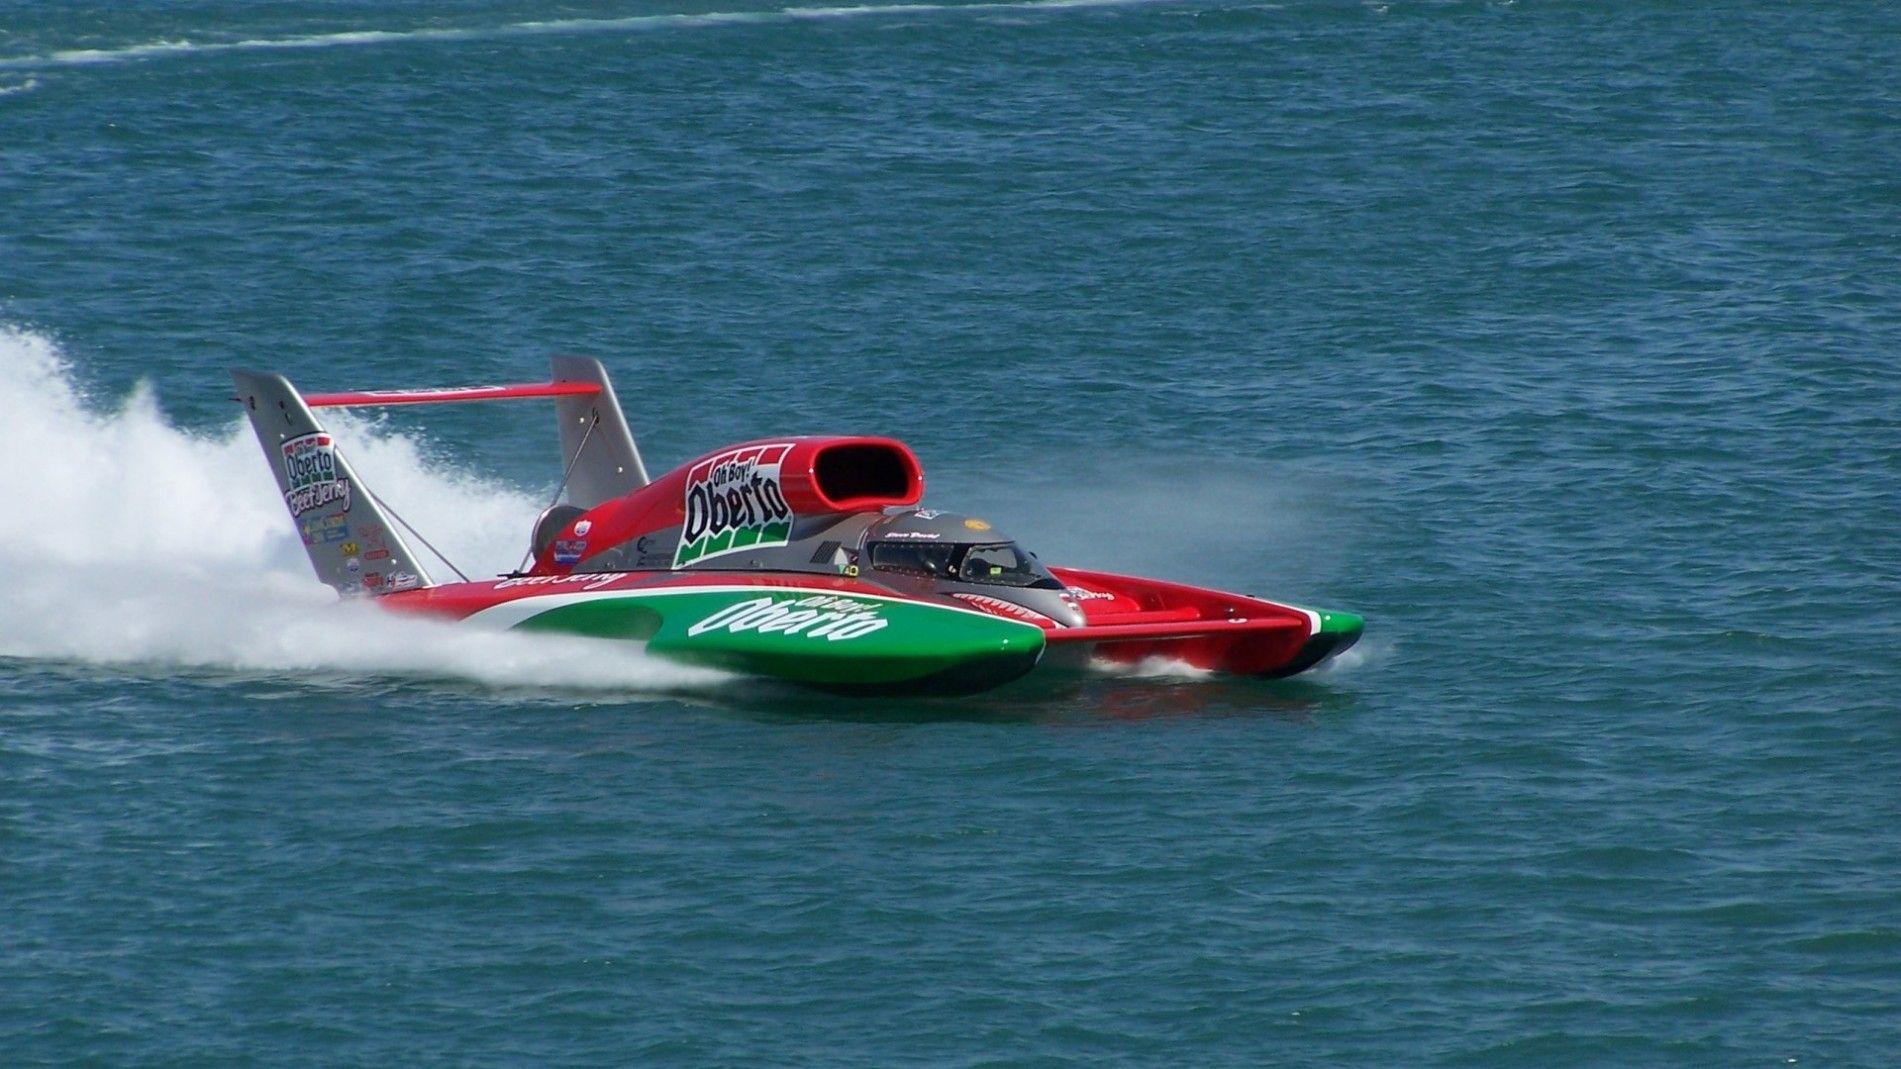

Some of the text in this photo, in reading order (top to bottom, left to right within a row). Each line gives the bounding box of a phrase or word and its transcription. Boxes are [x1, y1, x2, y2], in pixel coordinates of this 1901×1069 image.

[286, 449, 333, 480] Oberto
[713, 462, 752, 487] Oh Boy!
[685, 471, 790, 545] Oberto
[687, 597, 889, 642] Oberto
